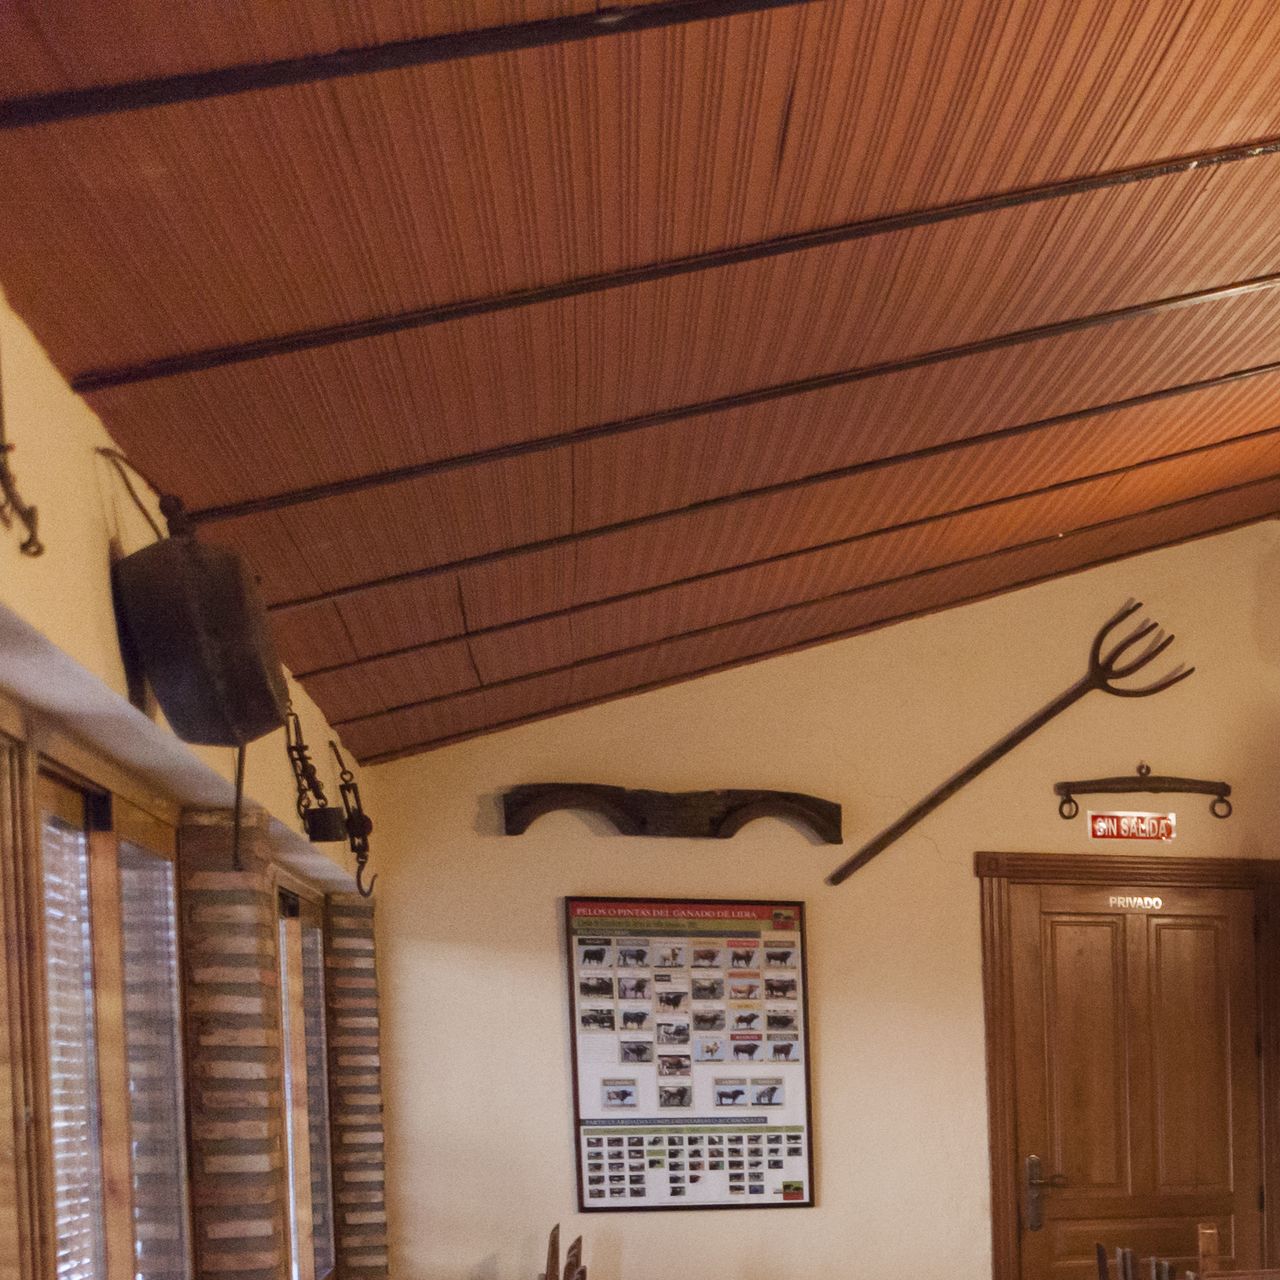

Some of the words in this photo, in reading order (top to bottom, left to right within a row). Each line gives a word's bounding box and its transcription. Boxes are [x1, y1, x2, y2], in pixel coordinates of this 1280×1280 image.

[1096, 817, 1117, 836] SIN
[1120, 817, 1167, 837] SALIDA
[1109, 896, 1163, 909] PRIVADO
[576, 908, 606, 916] PELOS
[617, 908, 651, 917] PINTAS
[652, 909, 669, 917] DEL
[672, 909, 715, 918] GANADO
[716, 910, 730, 918] DE
